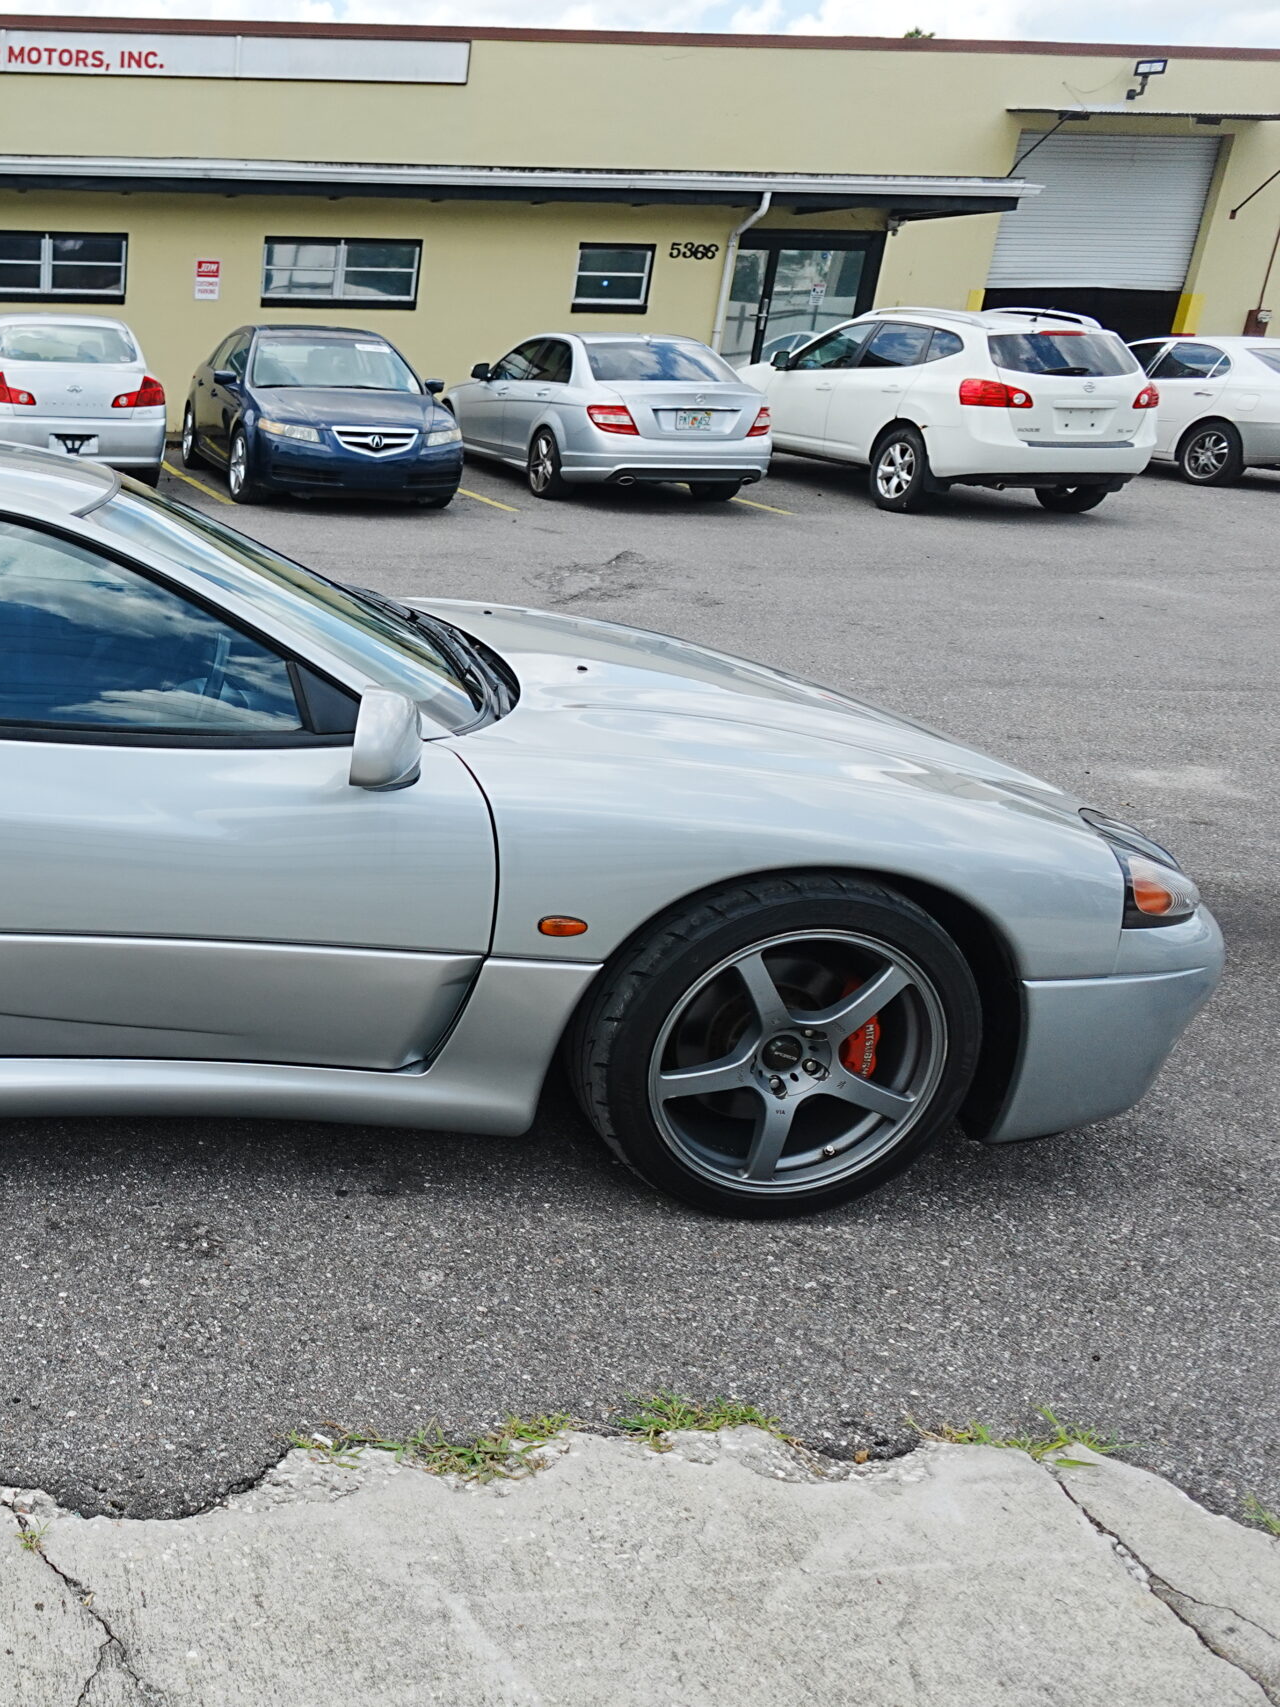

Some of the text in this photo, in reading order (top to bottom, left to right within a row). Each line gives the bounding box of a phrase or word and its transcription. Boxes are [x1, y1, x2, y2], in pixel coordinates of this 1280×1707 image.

[7, 46, 111, 71] MOTORS,
[119, 50, 165, 69] INC.
[198, 263, 218, 272] JDM
